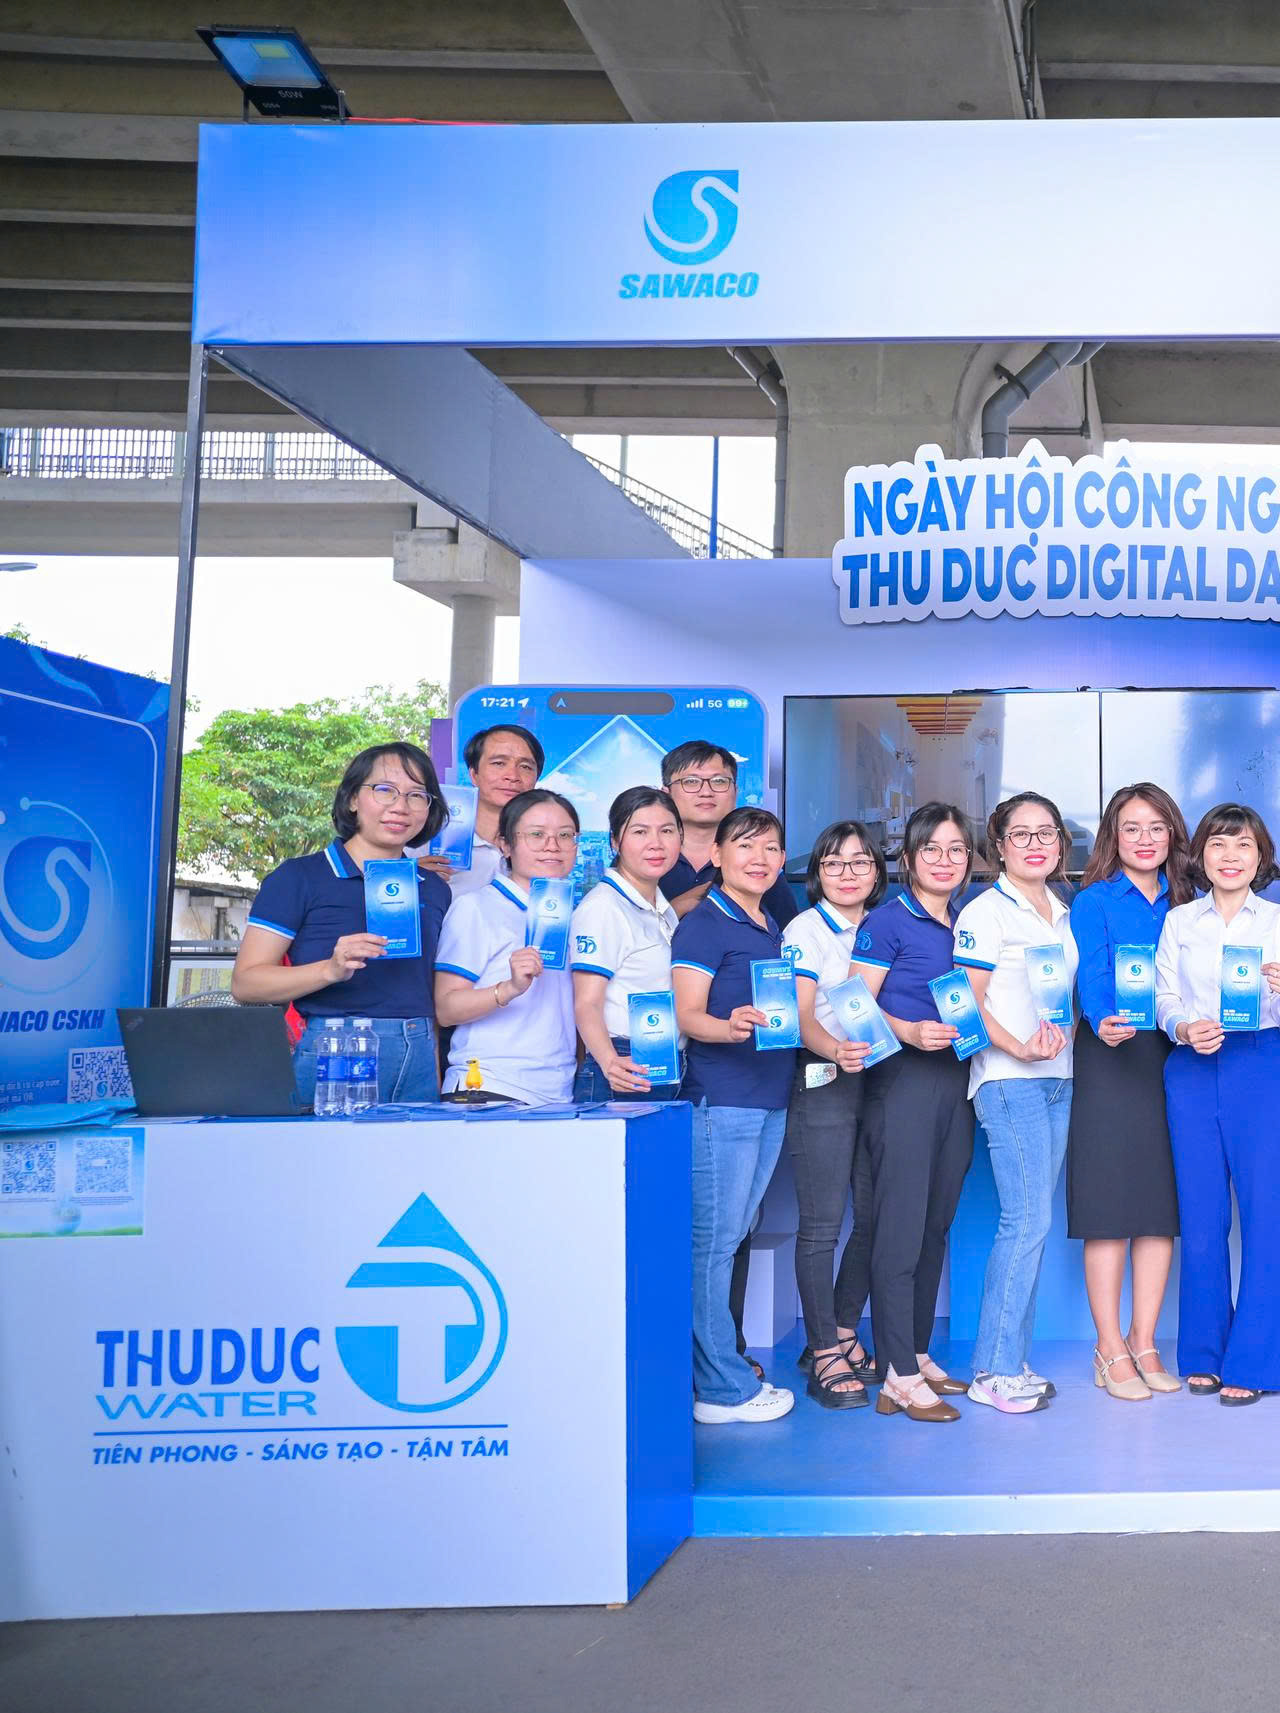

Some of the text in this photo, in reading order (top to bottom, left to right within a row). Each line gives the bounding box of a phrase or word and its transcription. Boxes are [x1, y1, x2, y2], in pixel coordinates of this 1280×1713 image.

[619, 271, 760, 299] SAWACO
[853, 459, 975, 538] NGÀY
[985, 455, 1065, 546] HỘI
[1081, 455, 1207, 531] CÔNG
[842, 547, 931, 610] THU
[1046, 543, 1218, 604] DIGITAL
[480, 697, 516, 708] 17:21
[707, 699, 723, 709] 5G
[0, 1010, 49, 1033] ACO
[52, 1009, 105, 1031] CSKH
[96, 1326, 321, 1387] THUDUC
[96, 1391, 318, 1420] WATER
[93, 1441, 142, 1465] TIÊN
[149, 1444, 239, 1463] PHONG
[261, 1438, 329, 1462] SÁNG
[336, 1442, 383, 1463] TẠO
[406, 1438, 457, 1460] TẬN
[461, 1437, 509, 1458] TÂM
